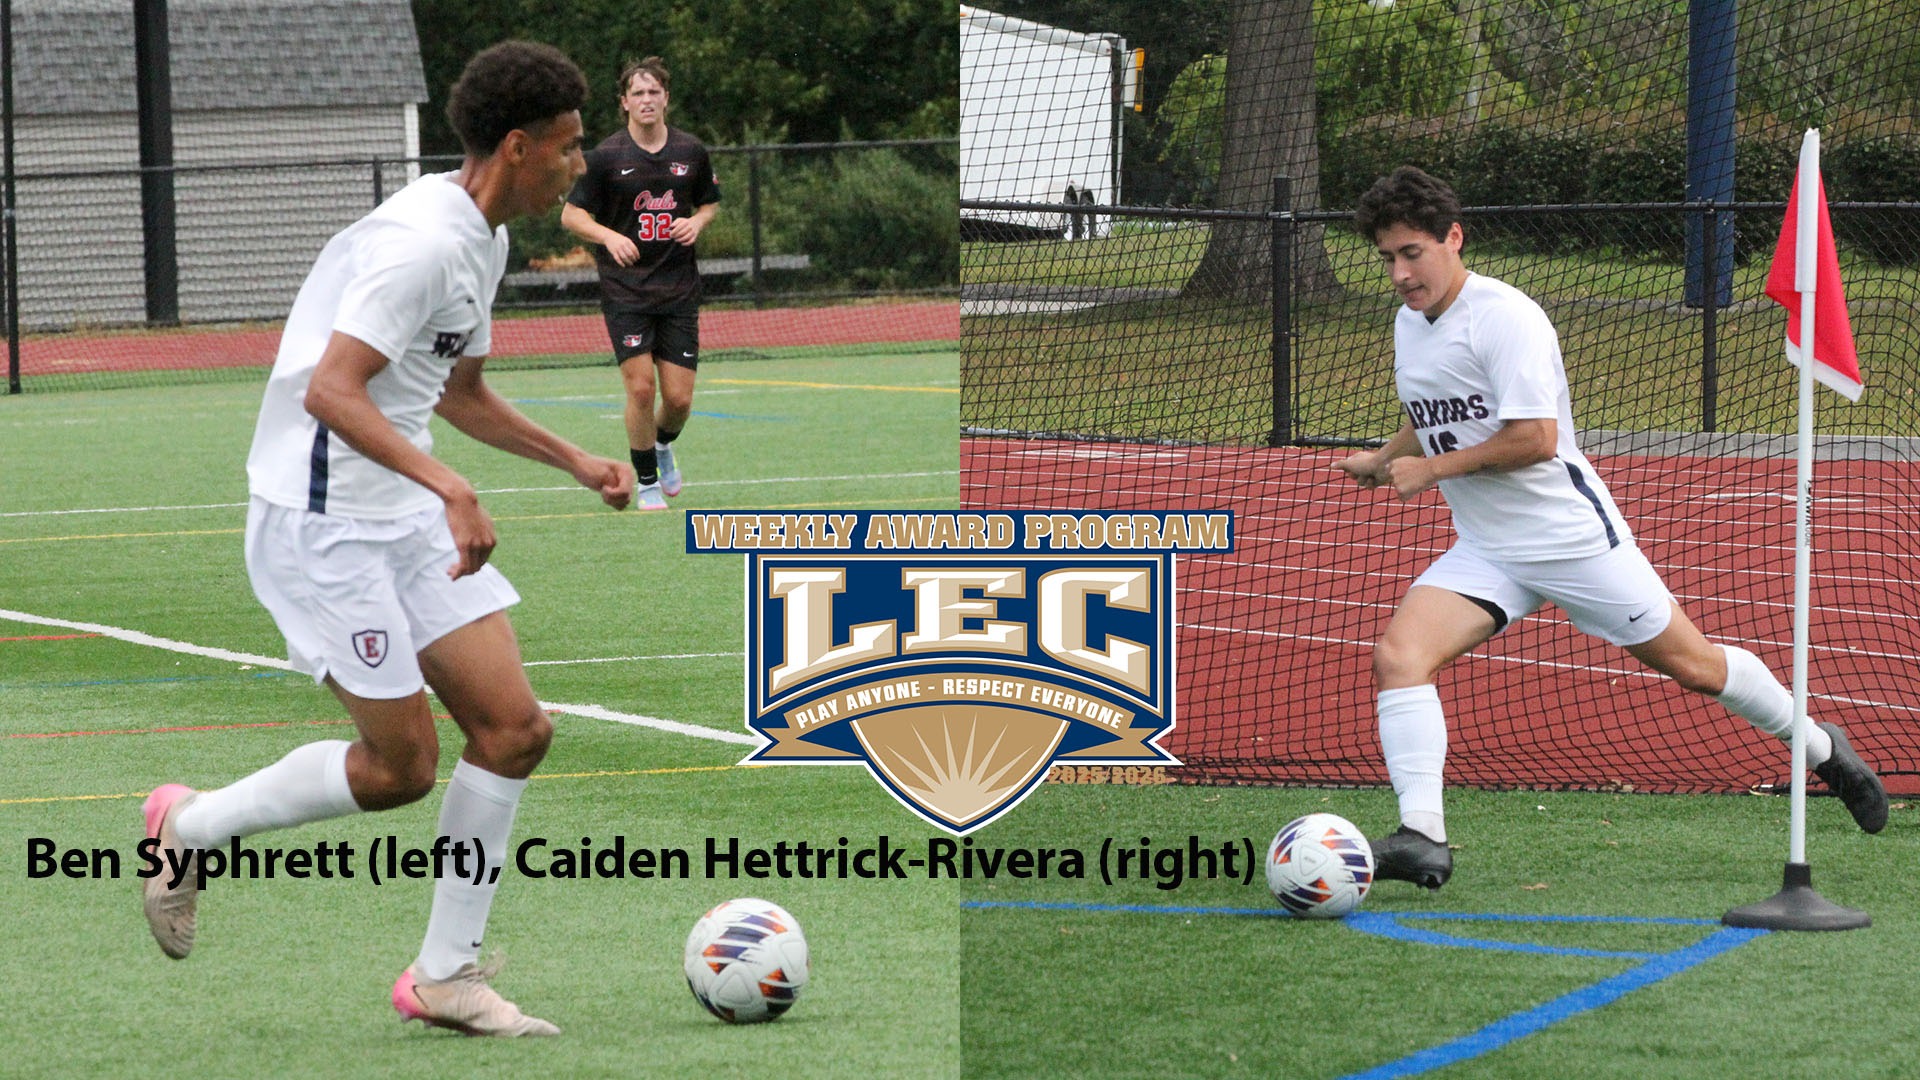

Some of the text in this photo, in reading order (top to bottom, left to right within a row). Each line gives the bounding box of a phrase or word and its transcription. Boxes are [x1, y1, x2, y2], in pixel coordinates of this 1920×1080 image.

[634, 189, 678, 211] Owls
[638, 213, 673, 241] 32
[363, 636, 379, 658] E
